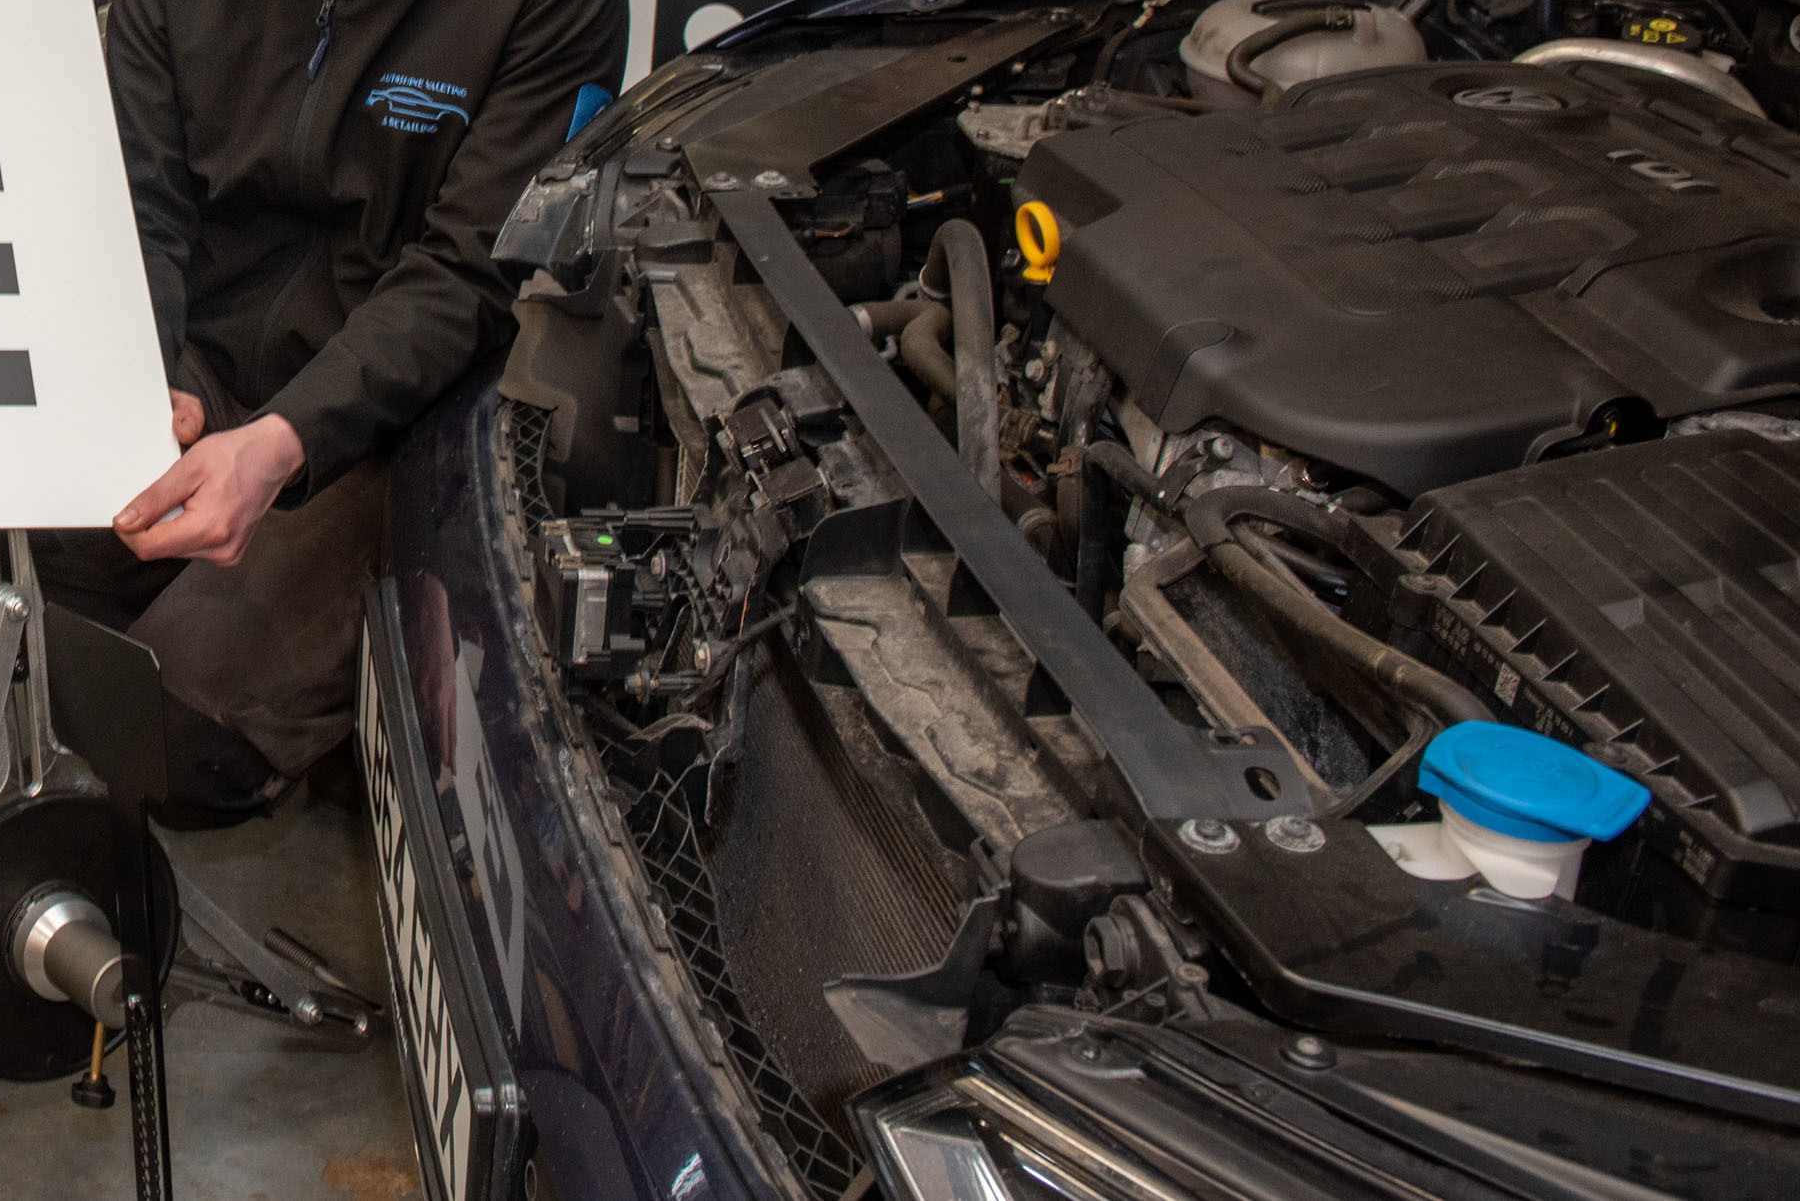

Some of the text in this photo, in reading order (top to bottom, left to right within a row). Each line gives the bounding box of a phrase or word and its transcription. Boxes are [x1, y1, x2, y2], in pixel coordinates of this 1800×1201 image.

[424, 78, 469, 98] VALETING
[388, 117, 438, 134] DETAILING
[365, 648, 407, 944] LB64
[407, 906, 464, 1201] EHX
